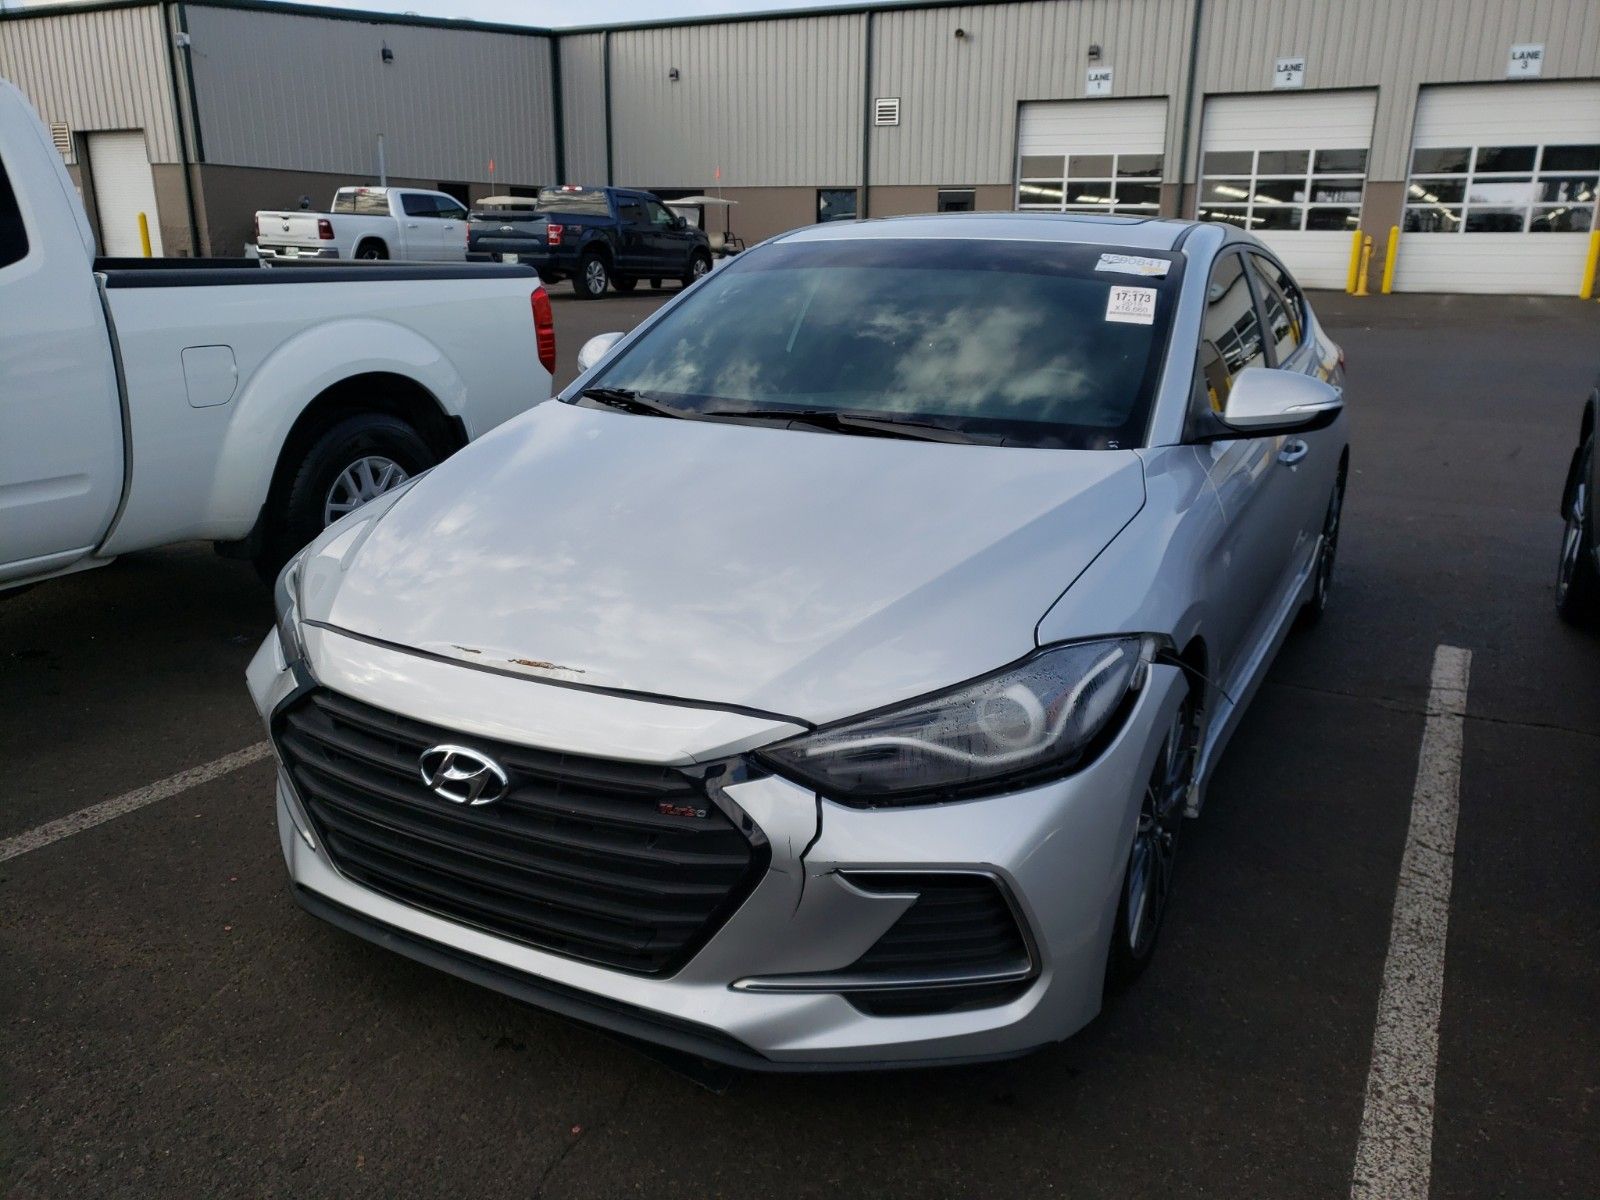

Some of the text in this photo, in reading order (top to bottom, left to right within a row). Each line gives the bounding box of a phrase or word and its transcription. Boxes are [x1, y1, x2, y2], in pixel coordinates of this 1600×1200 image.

[1512, 51, 1540, 60] LANE
[1277, 63, 1302, 72] LANE
[1521, 60, 1528, 70] 3
[1088, 72, 1112, 81] LANE
[1286, 72, 1292, 81] 2
[1115, 292, 1151, 303] 17:173
